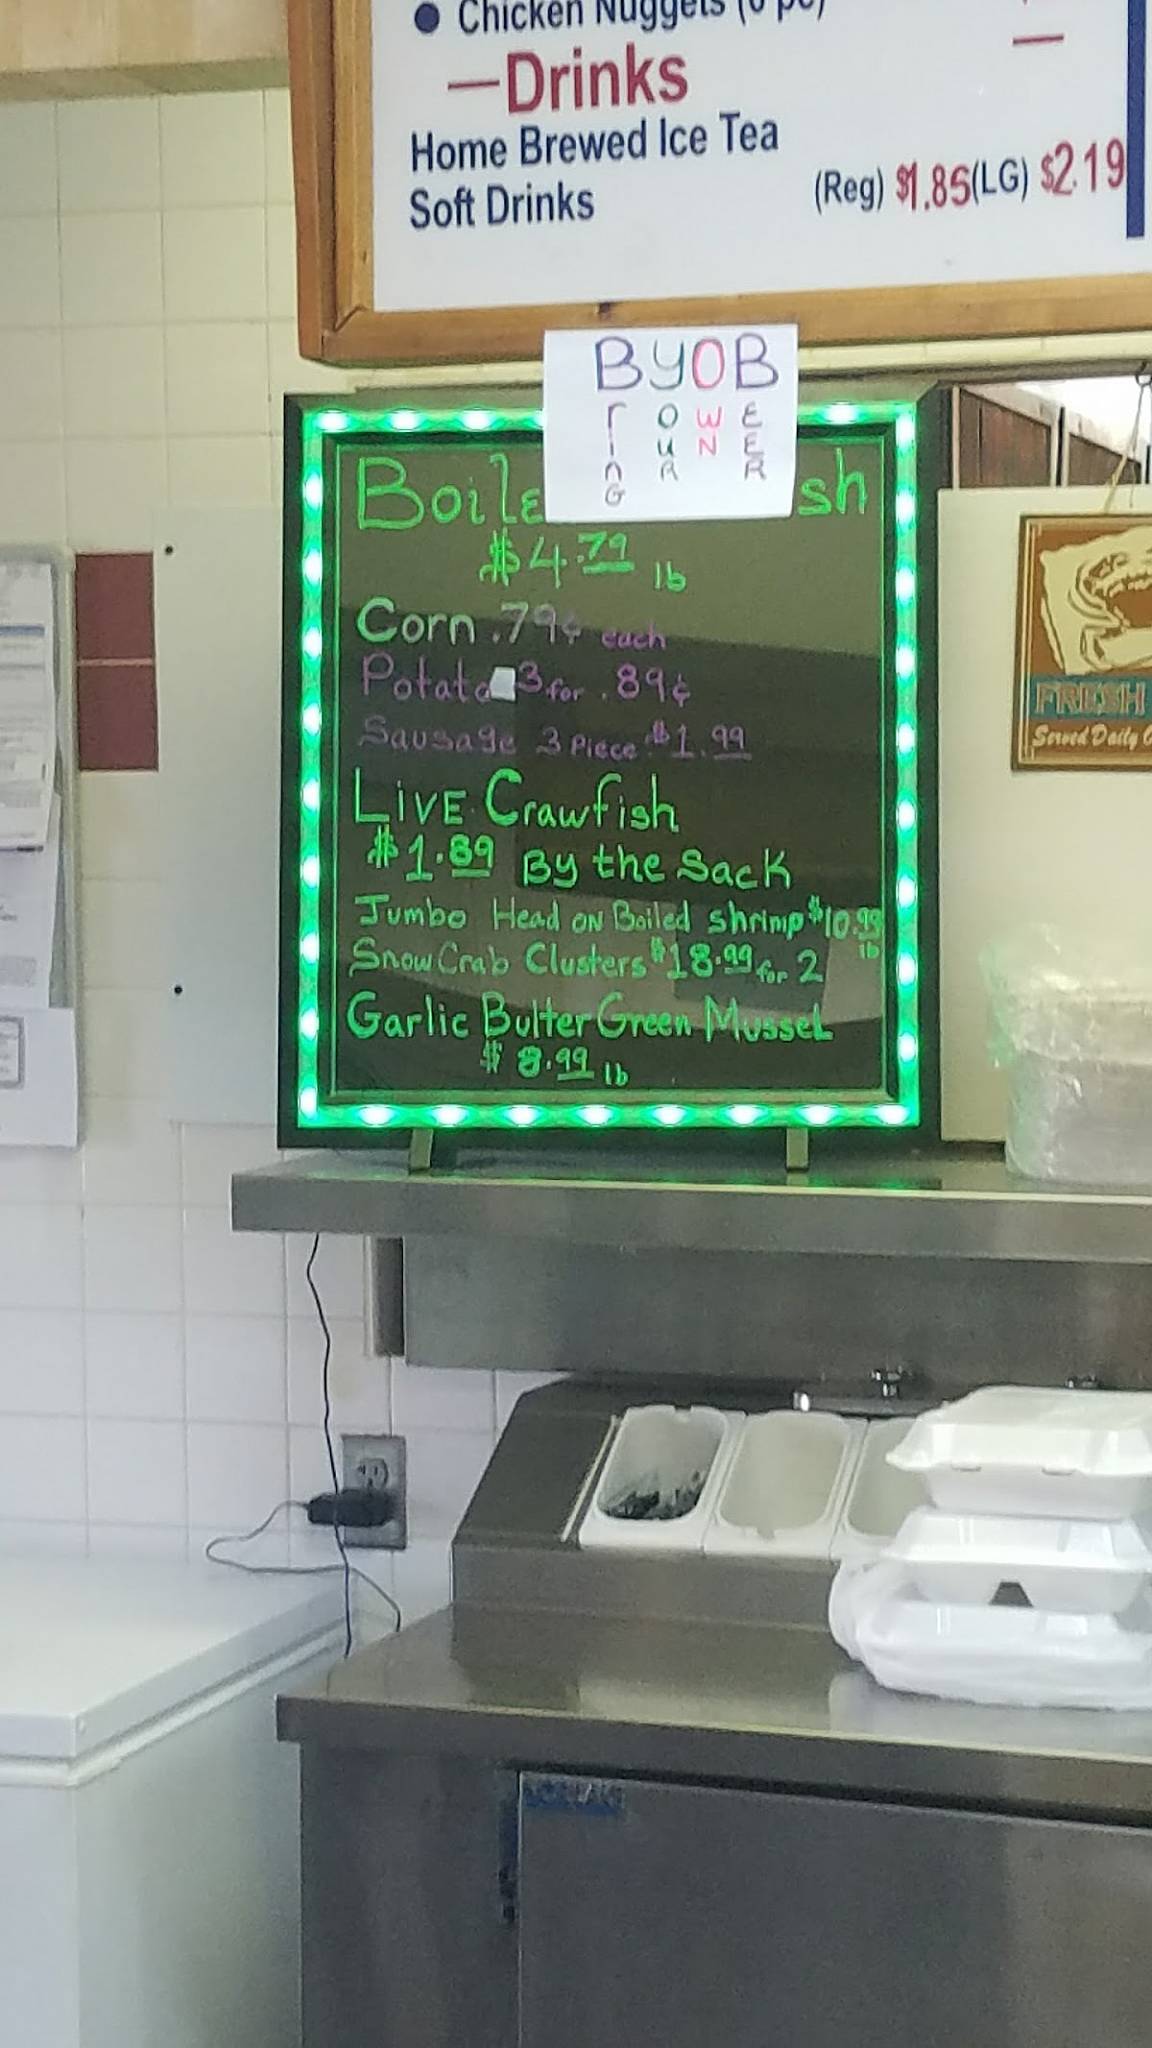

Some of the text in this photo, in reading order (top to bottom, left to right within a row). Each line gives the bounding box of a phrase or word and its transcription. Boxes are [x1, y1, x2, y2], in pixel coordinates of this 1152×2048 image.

[458, 0, 583, 34] Chicken
[507, 42, 689, 114] Drinks
[412, 110, 779, 172] Home Brewed Ice Tea
[410, 181, 595, 229] Soft Drinks
[815, 168, 884, 214] (Reg)
[896, 161, 971, 211] $1.85
[972, 157, 1028, 205] (LG)
[357, 453, 545, 530] Boile
[357, 596, 475, 644] Corn
[536, 726, 561, 755] 3
[485, 768, 680, 834] Crawfish
[523, 848, 578, 889] By
[592, 843, 666, 884] the
[355, 894, 466, 929] Jumbo
[493, 896, 559, 932] Head
[612, 899, 691, 932] Boiled
[525, 941, 647, 978] Clusters
[797, 949, 823, 983] 2
[347, 991, 470, 1039] Garlic
[598, 991, 692, 1039] Green
